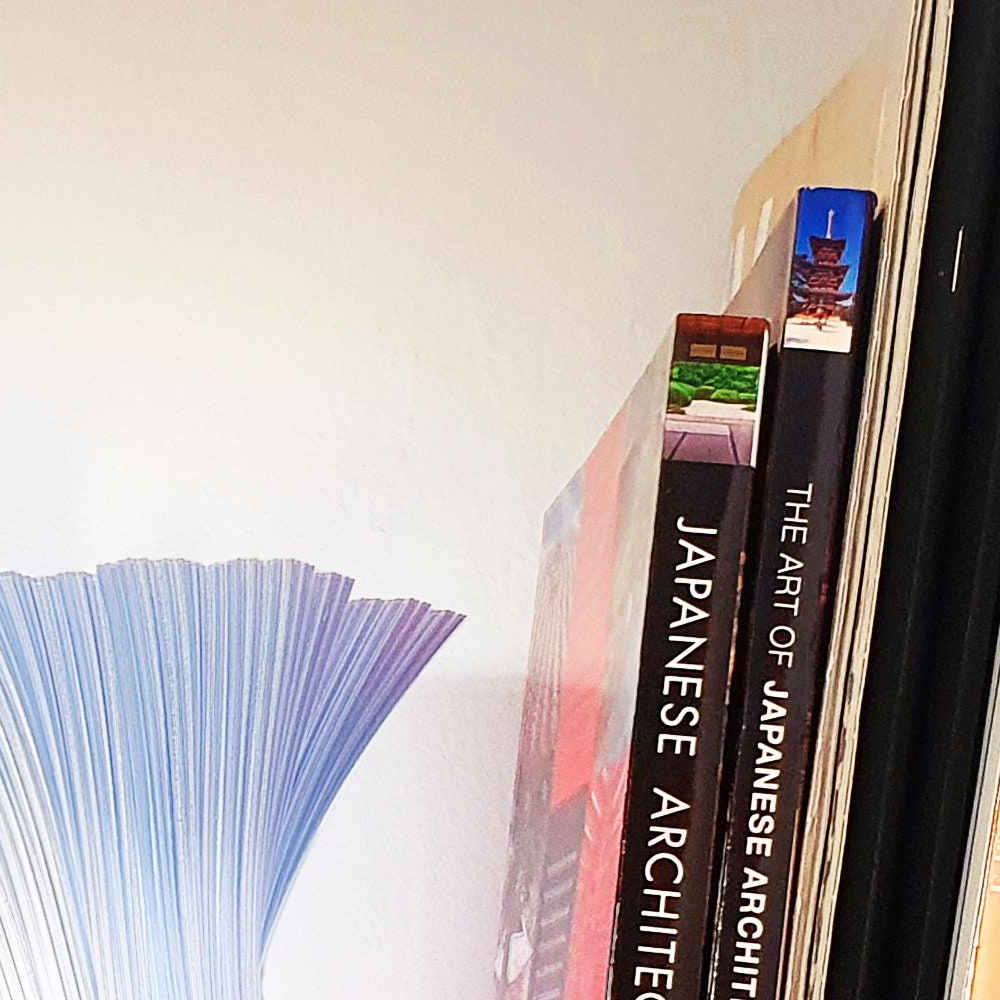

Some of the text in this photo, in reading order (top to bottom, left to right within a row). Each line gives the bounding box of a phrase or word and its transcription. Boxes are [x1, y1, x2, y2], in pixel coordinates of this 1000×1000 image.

[781, 482, 813, 545] THE
[773, 552, 804, 617] ART
[657, 516, 718, 758] JAPANESE
[768, 625, 796, 669] OF
[744, 679, 789, 858] JAPANESE
